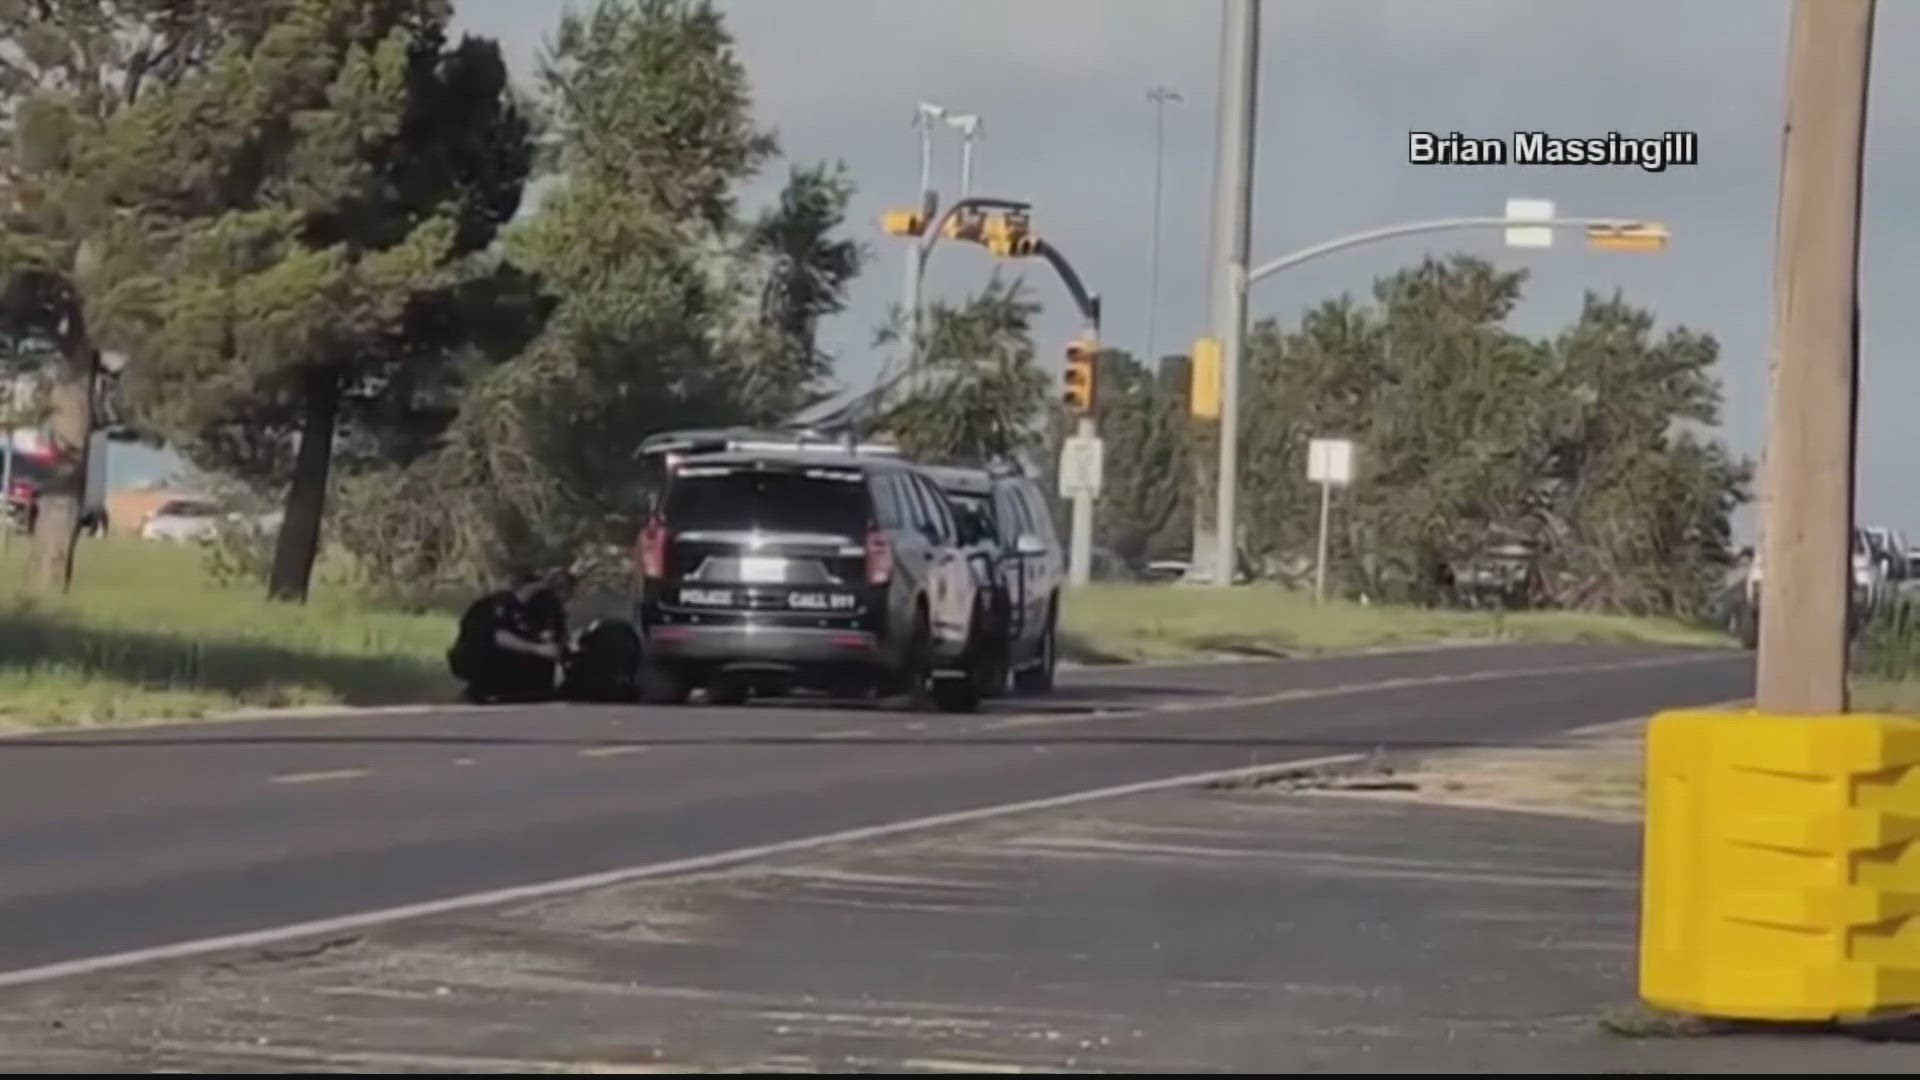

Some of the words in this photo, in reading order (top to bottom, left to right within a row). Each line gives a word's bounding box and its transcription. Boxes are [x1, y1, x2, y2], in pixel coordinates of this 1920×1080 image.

[679, 589, 733, 605] POLICE
[788, 591, 828, 608] CALL
[829, 593, 855, 608] 911
